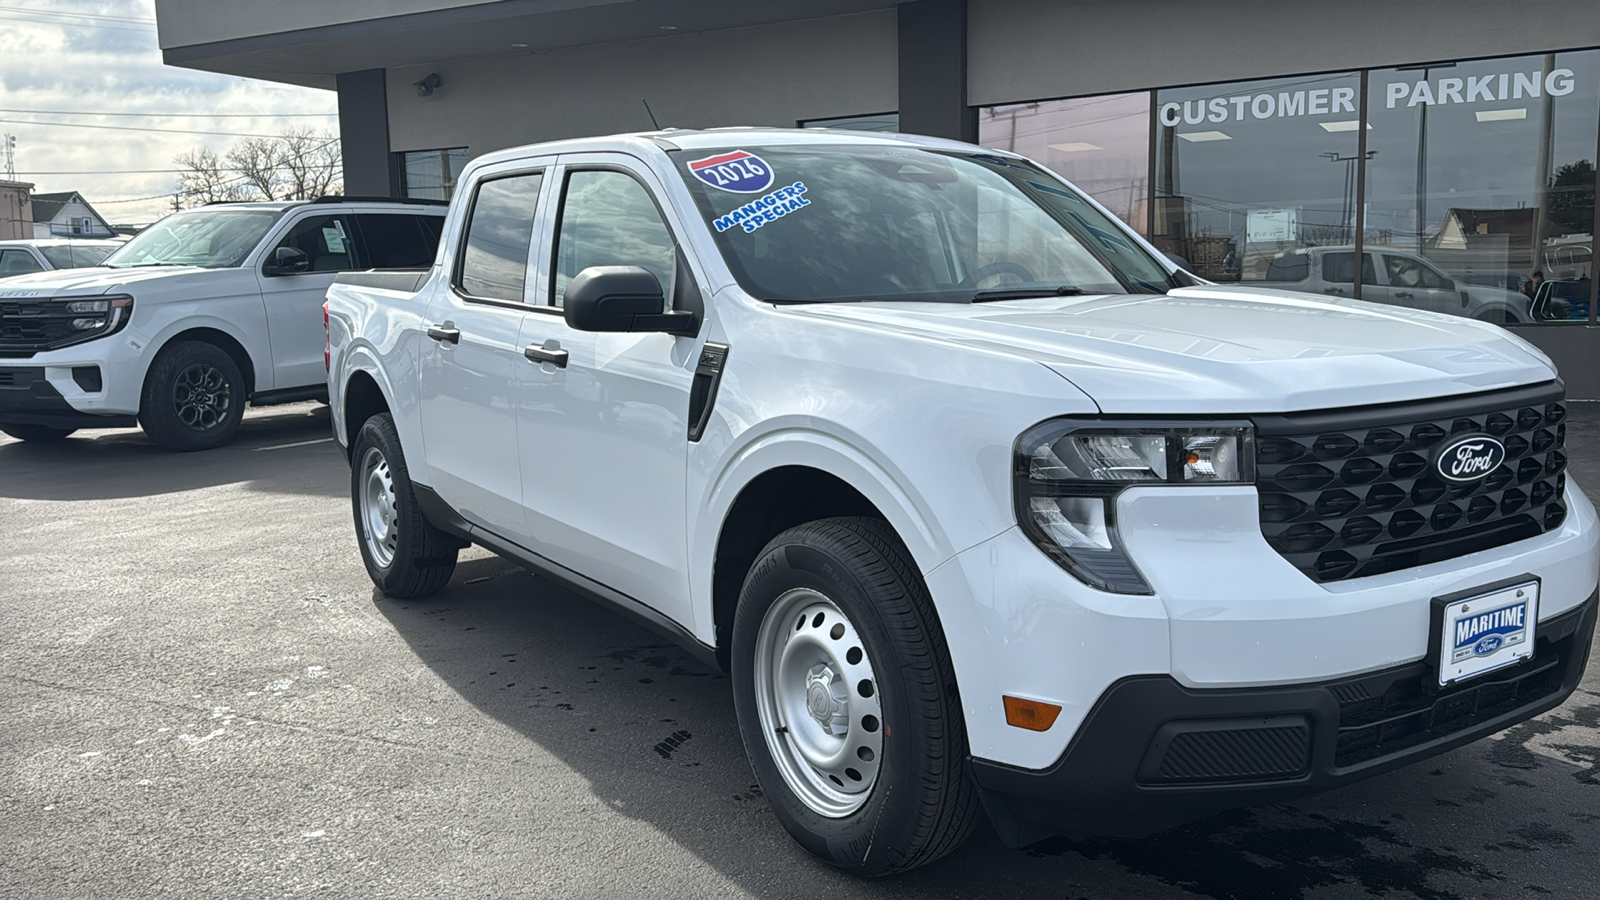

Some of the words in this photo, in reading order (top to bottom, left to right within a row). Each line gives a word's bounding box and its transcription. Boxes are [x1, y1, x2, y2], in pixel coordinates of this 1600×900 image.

[1160, 87, 1356, 127] CUSTOMER
[1386, 68, 1575, 109] PARKING
[704, 159, 765, 186] 2026
[713, 182, 807, 232] MANAGERS
[741, 196, 810, 233] SPECIAL
[1452, 443, 1494, 476] Ford
[1456, 604, 1525, 646] MARITIME
[1478, 638, 1499, 653] Ford
